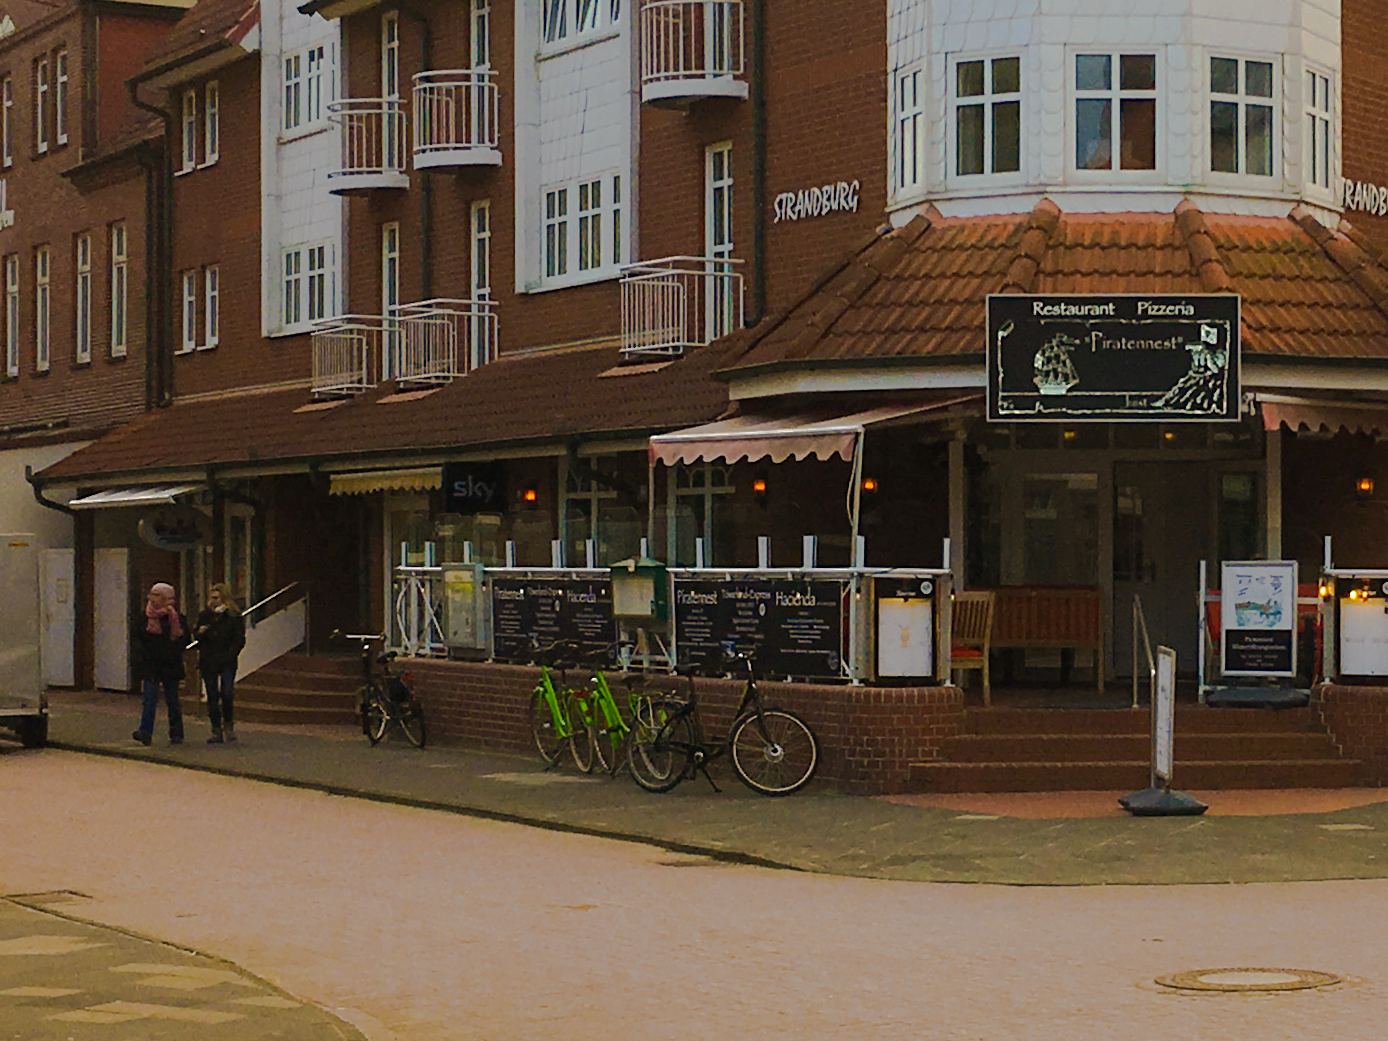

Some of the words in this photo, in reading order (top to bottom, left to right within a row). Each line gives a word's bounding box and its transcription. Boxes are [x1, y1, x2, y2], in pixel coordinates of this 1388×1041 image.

[773, 179, 860, 224] STRANDBURG
[1032, 301, 1116, 316] Restaurant
[1137, 300, 1195, 316] Pizzeria
[453, 475, 497, 504] sky
